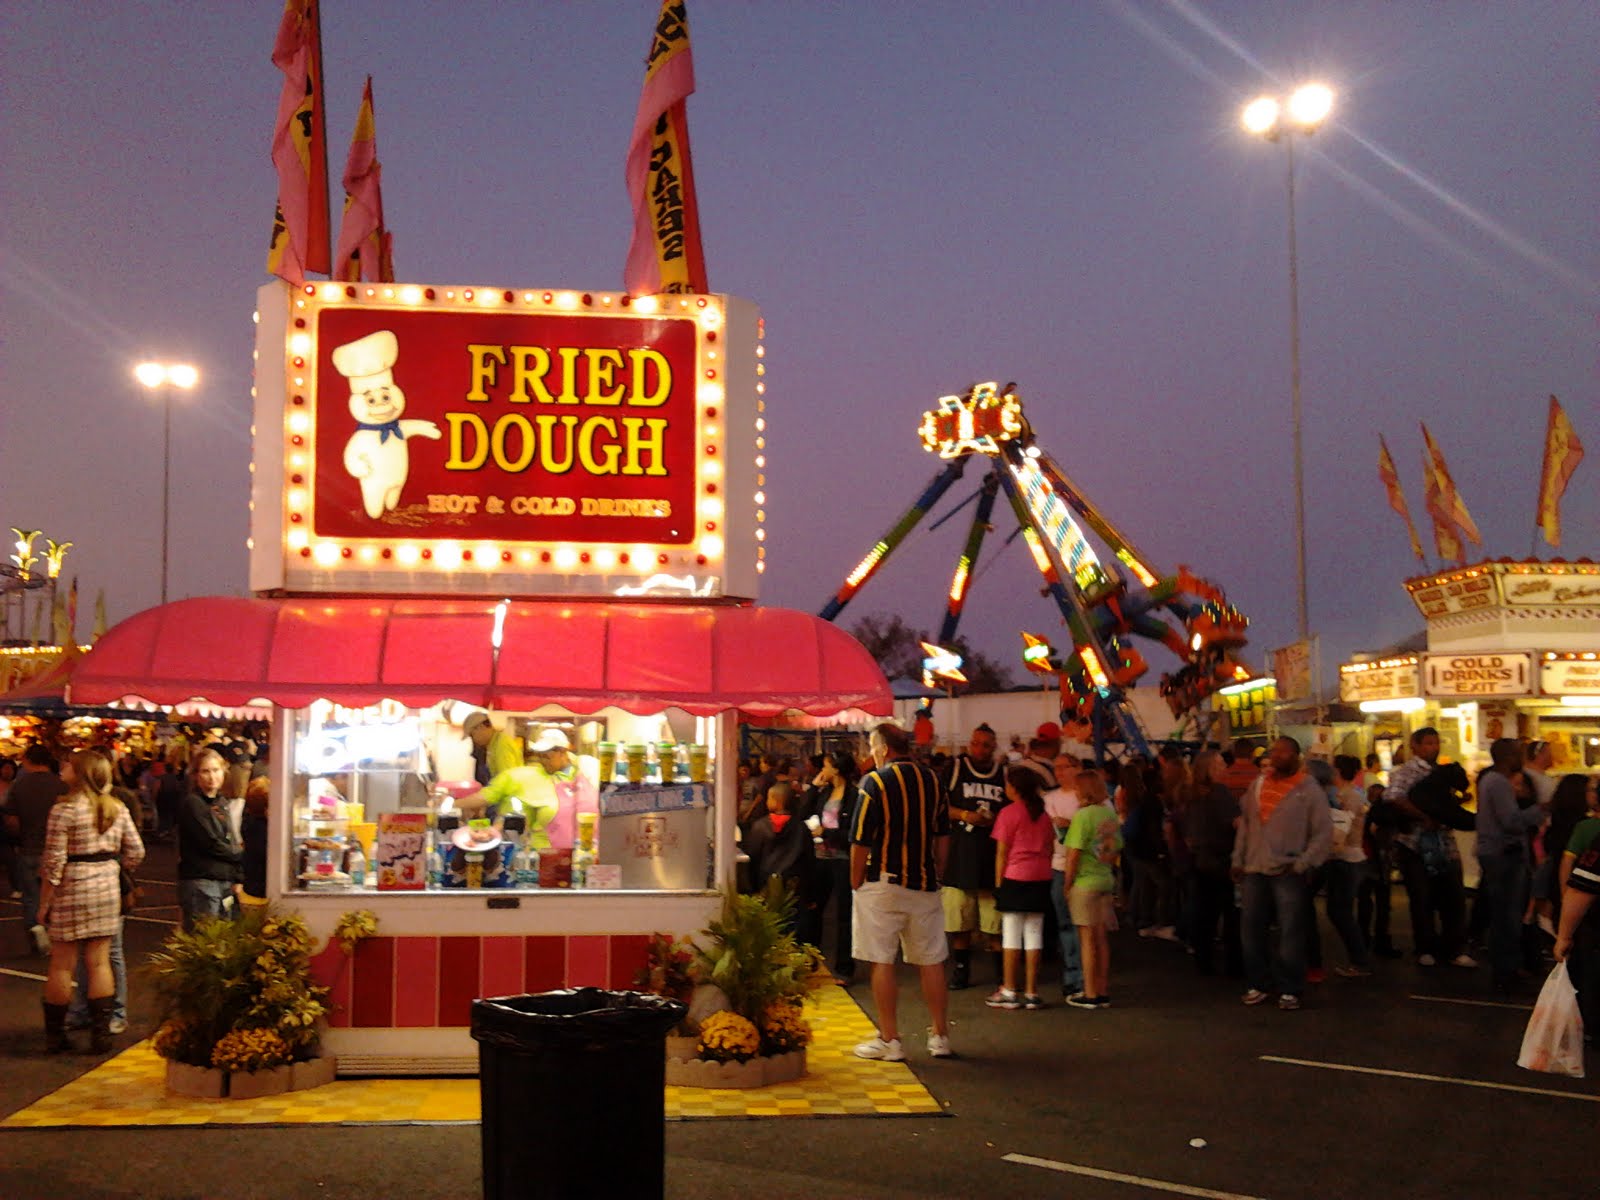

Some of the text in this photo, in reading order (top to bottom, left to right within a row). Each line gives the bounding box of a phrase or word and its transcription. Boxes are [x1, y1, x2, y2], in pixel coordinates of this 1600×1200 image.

[466, 344, 673, 407] FRIED
[444, 412, 669, 476] DOUGH
[427, 494, 672, 517] HOT & COLD DRINKS
[1450, 657, 1503, 669] COLD
[1442, 668, 1513, 681] DRINKS
[1455, 681, 1498, 693] EXIT
[962, 782, 1004, 802] WAKE
